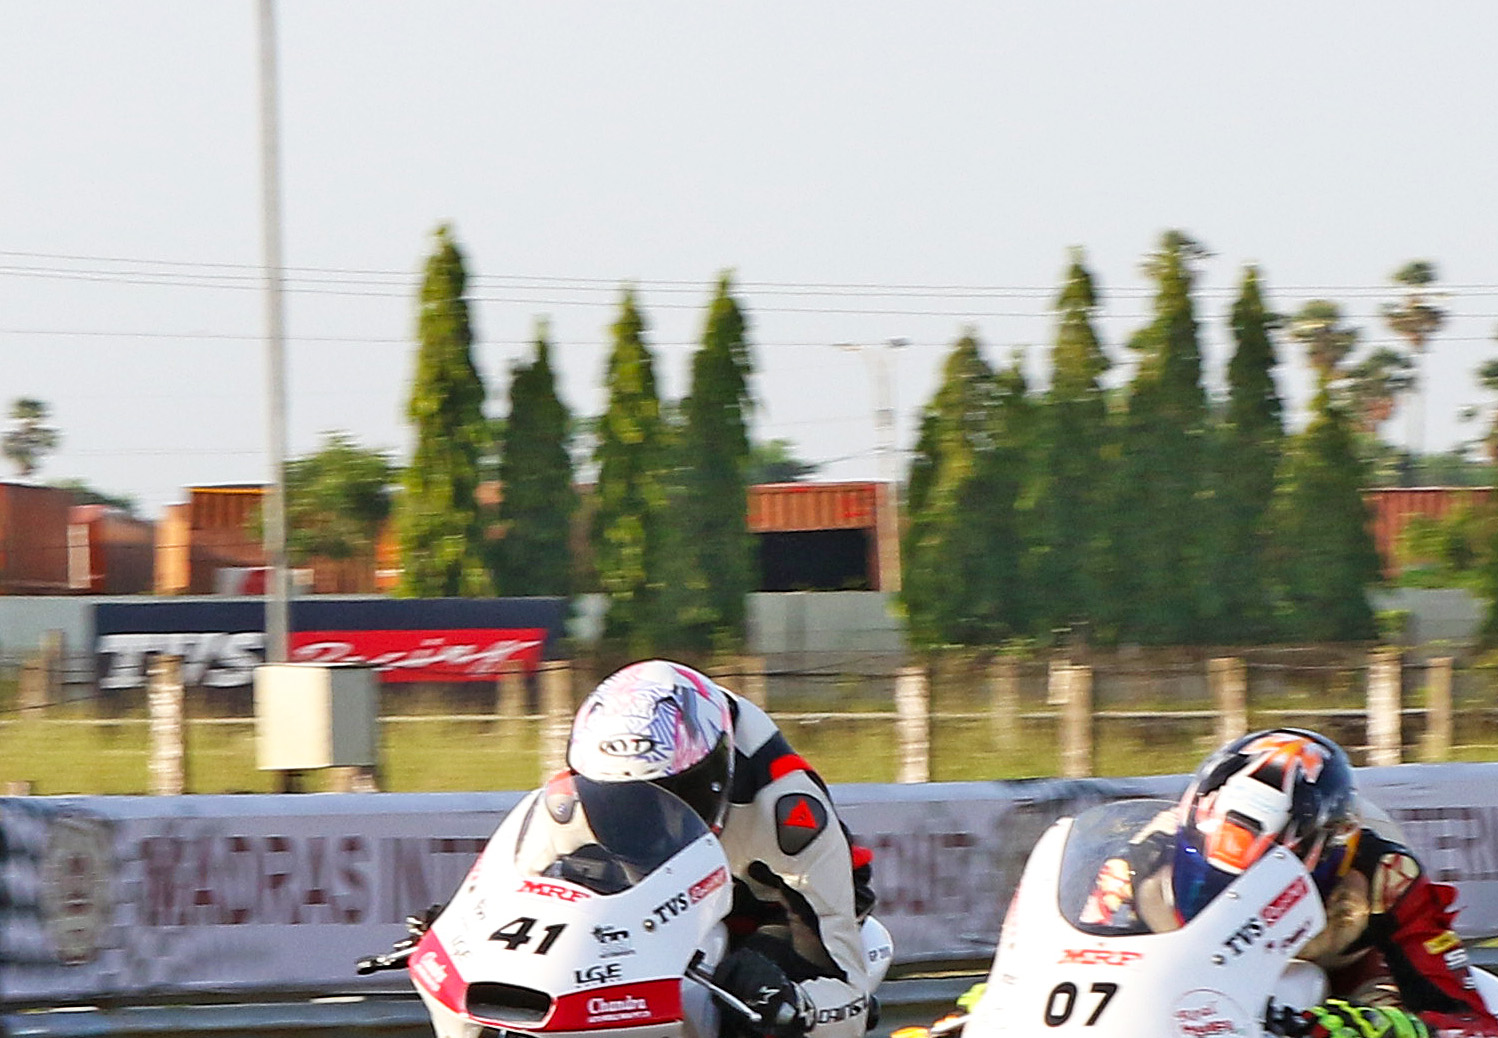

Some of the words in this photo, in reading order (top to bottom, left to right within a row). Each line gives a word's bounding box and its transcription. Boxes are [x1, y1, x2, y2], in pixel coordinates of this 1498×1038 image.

[516, 880, 591, 902] MRF
[653, 893, 689, 924] TVS
[488, 916, 568, 956] 41
[1044, 981, 1118, 1027] 07
